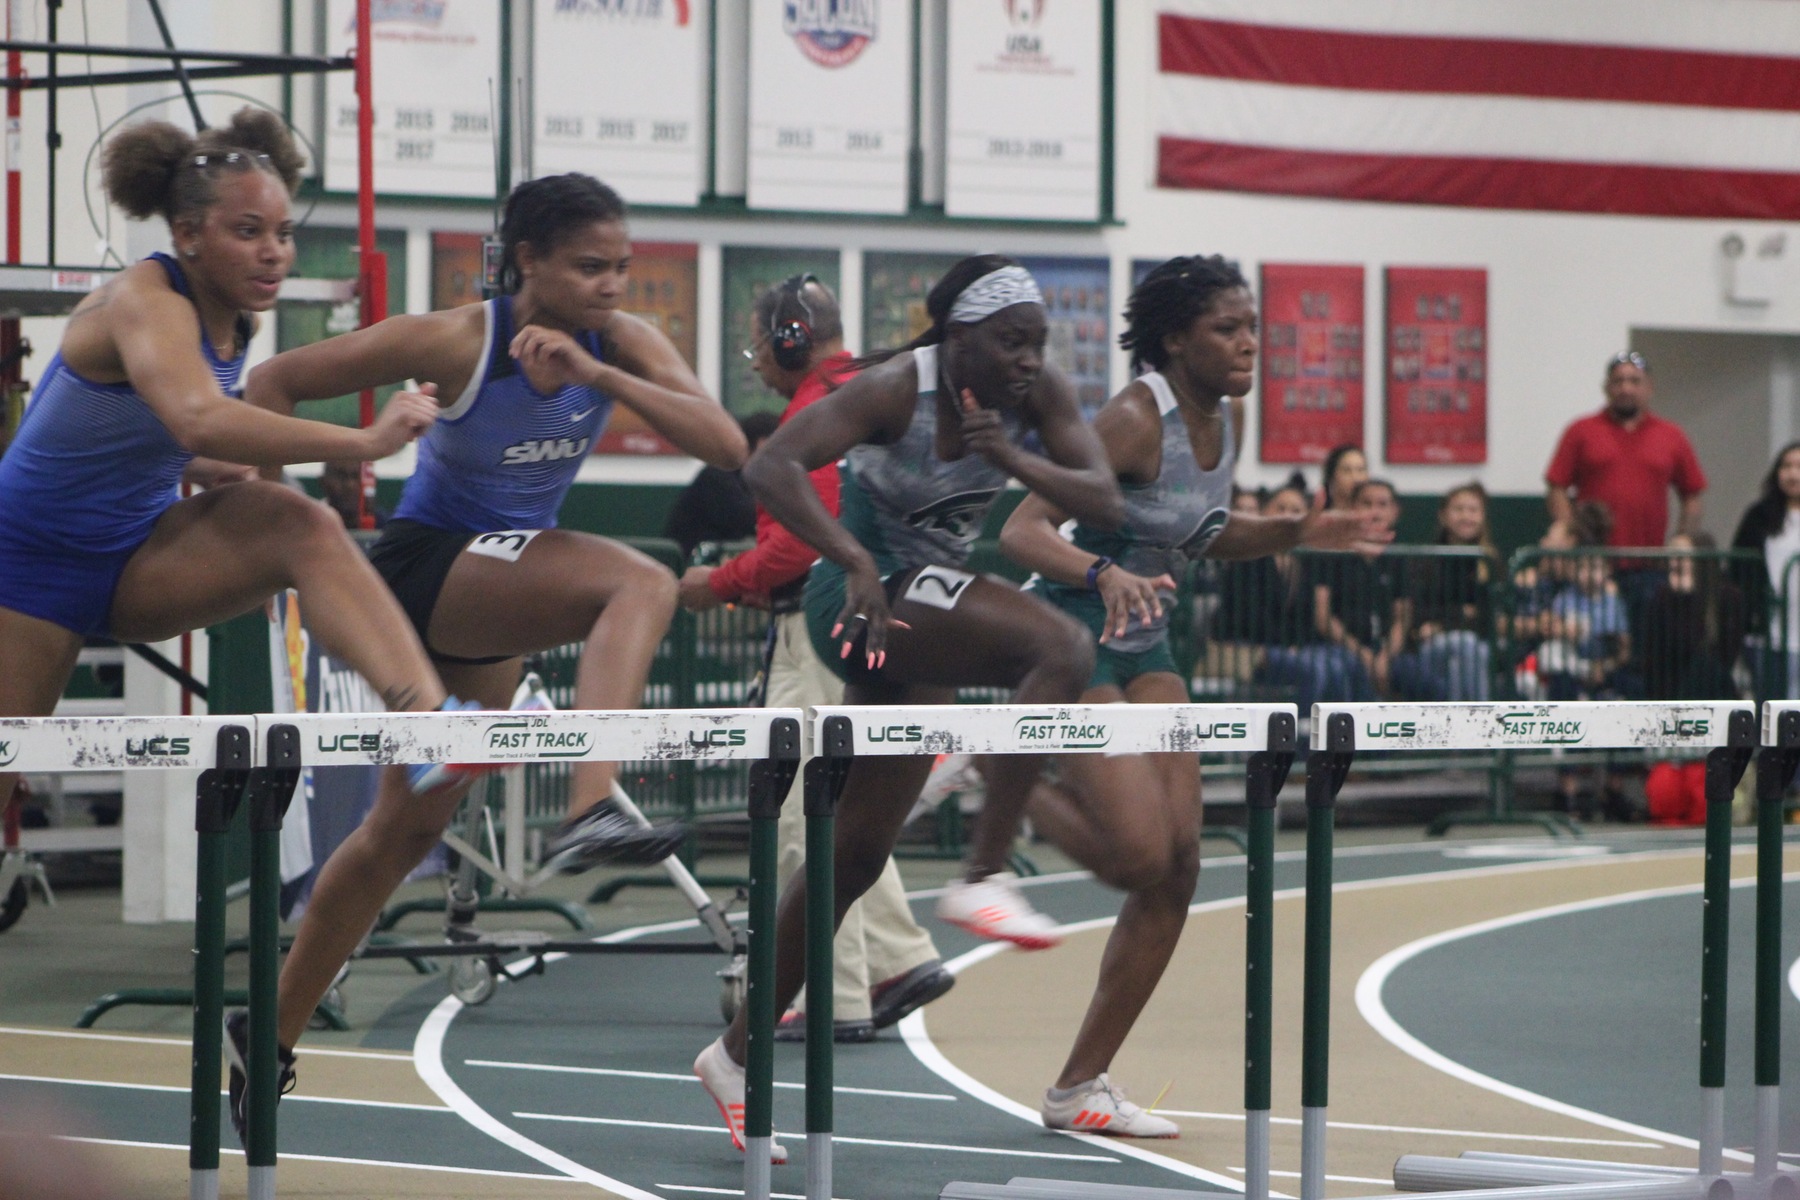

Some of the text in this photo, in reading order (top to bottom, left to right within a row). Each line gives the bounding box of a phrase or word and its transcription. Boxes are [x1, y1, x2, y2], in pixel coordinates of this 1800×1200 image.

[501, 437, 590, 465] SWU
[479, 534, 527, 551] 3
[916, 574, 965, 597] 2
[531, 719, 548, 728] JDL
[1055, 711, 1071, 720] JDL
[868, 726, 923, 742] UCS
[1019, 725, 1106, 740] FAST TRACK
[1196, 723, 1248, 739] UCS
[1366, 722, 1416, 738] UCS
[1503, 721, 1581, 735] FAST TRACK
[1662, 720, 1709, 736] UCS
[126, 737, 190, 756] UCS
[318, 734, 380, 752] UCS
[489, 732, 587, 748] FAST TRACK
[689, 729, 747, 748] UCS
